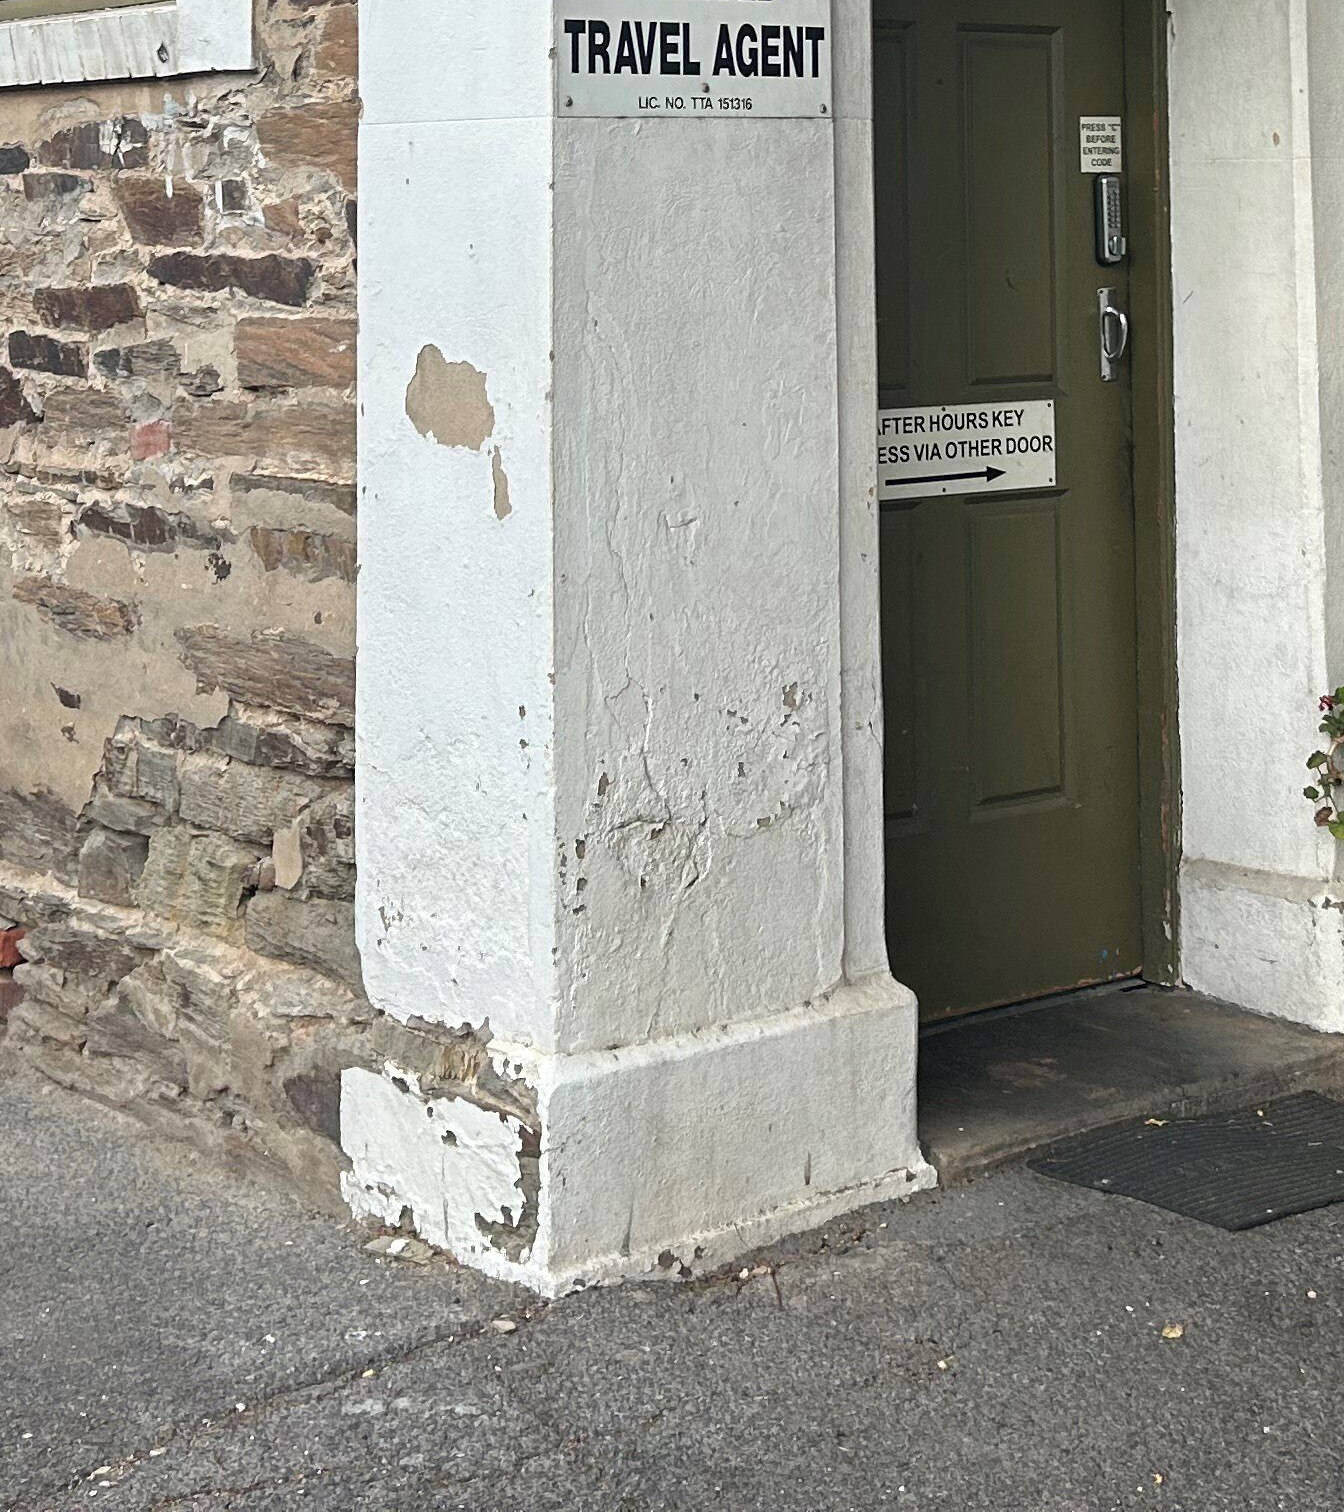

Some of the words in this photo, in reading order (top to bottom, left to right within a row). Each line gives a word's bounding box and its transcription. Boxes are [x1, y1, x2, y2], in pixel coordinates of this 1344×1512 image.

[564, 19, 701, 76] TRAVEL
[712, 23, 825, 78] AGENT
[665, 96, 686, 109] NO.
[691, 97, 713, 109] TTA
[718, 97, 752, 110] 151316
[1086, 134, 1116, 143] BEFORE
[1083, 147, 1119, 155] ENTERING
[1091, 158, 1112, 166] CODE
[929, 412, 989, 432] HOURS
[992, 409, 1024, 427] KEY
[913, 443, 942, 461] VIA
[945, 439, 1001, 459] OTHER
[1006, 435, 1053, 455] DOOR
